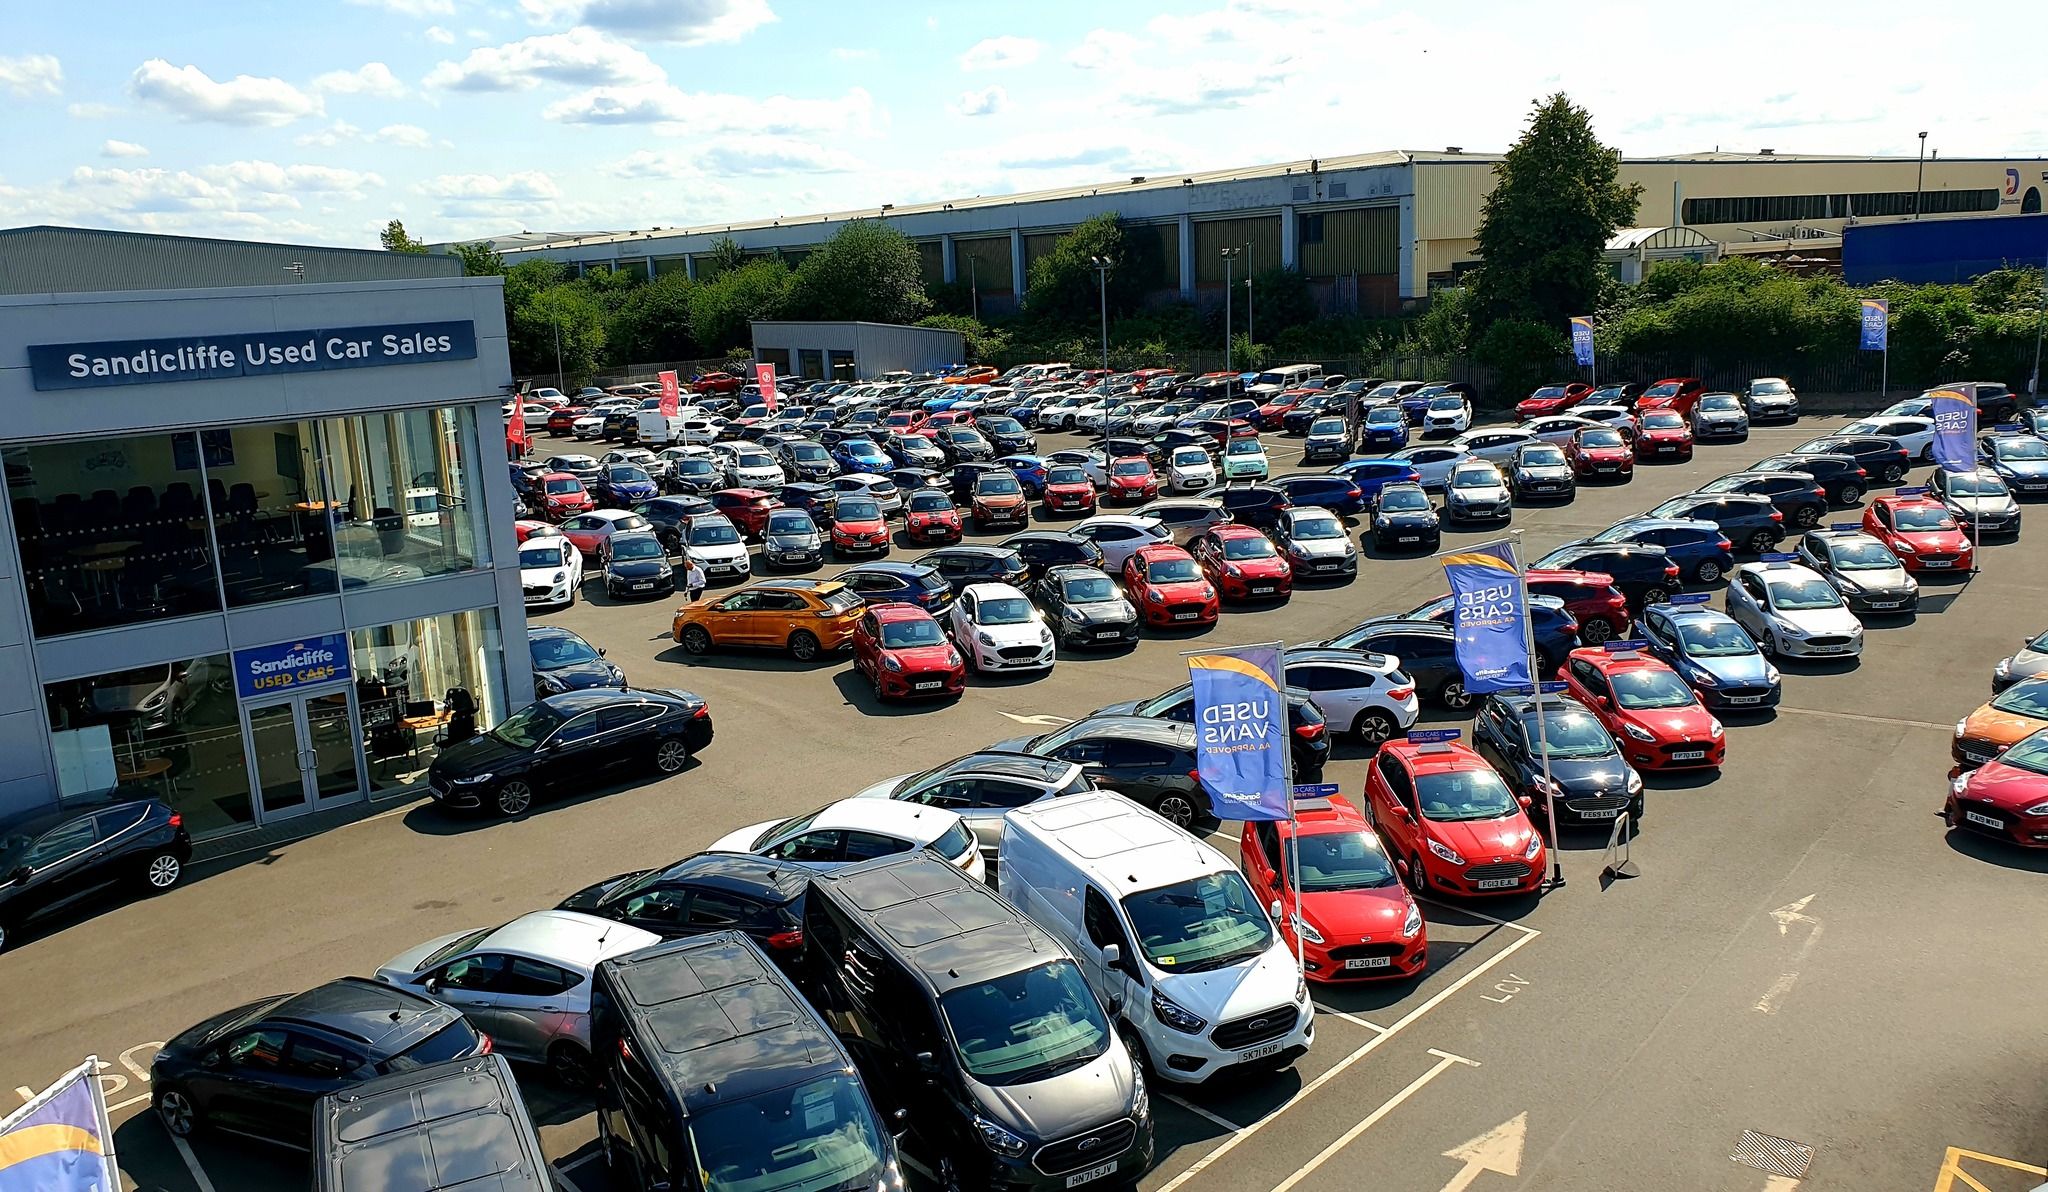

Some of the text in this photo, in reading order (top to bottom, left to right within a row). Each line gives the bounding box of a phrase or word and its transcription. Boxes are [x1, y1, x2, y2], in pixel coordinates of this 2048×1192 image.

[68, 332, 451, 378] Sandicliffe Used Car Sales
[250, 649, 334, 675] Sandicliffe
[254, 665, 335, 689] USED CARS
[1348, 957, 1387, 967] FL20 RGY
[1480, 973, 1530, 1003] LCV
[1243, 1044, 1278, 1060] SK71 RXP
[1072, 1171, 1093, 1186] HN71
